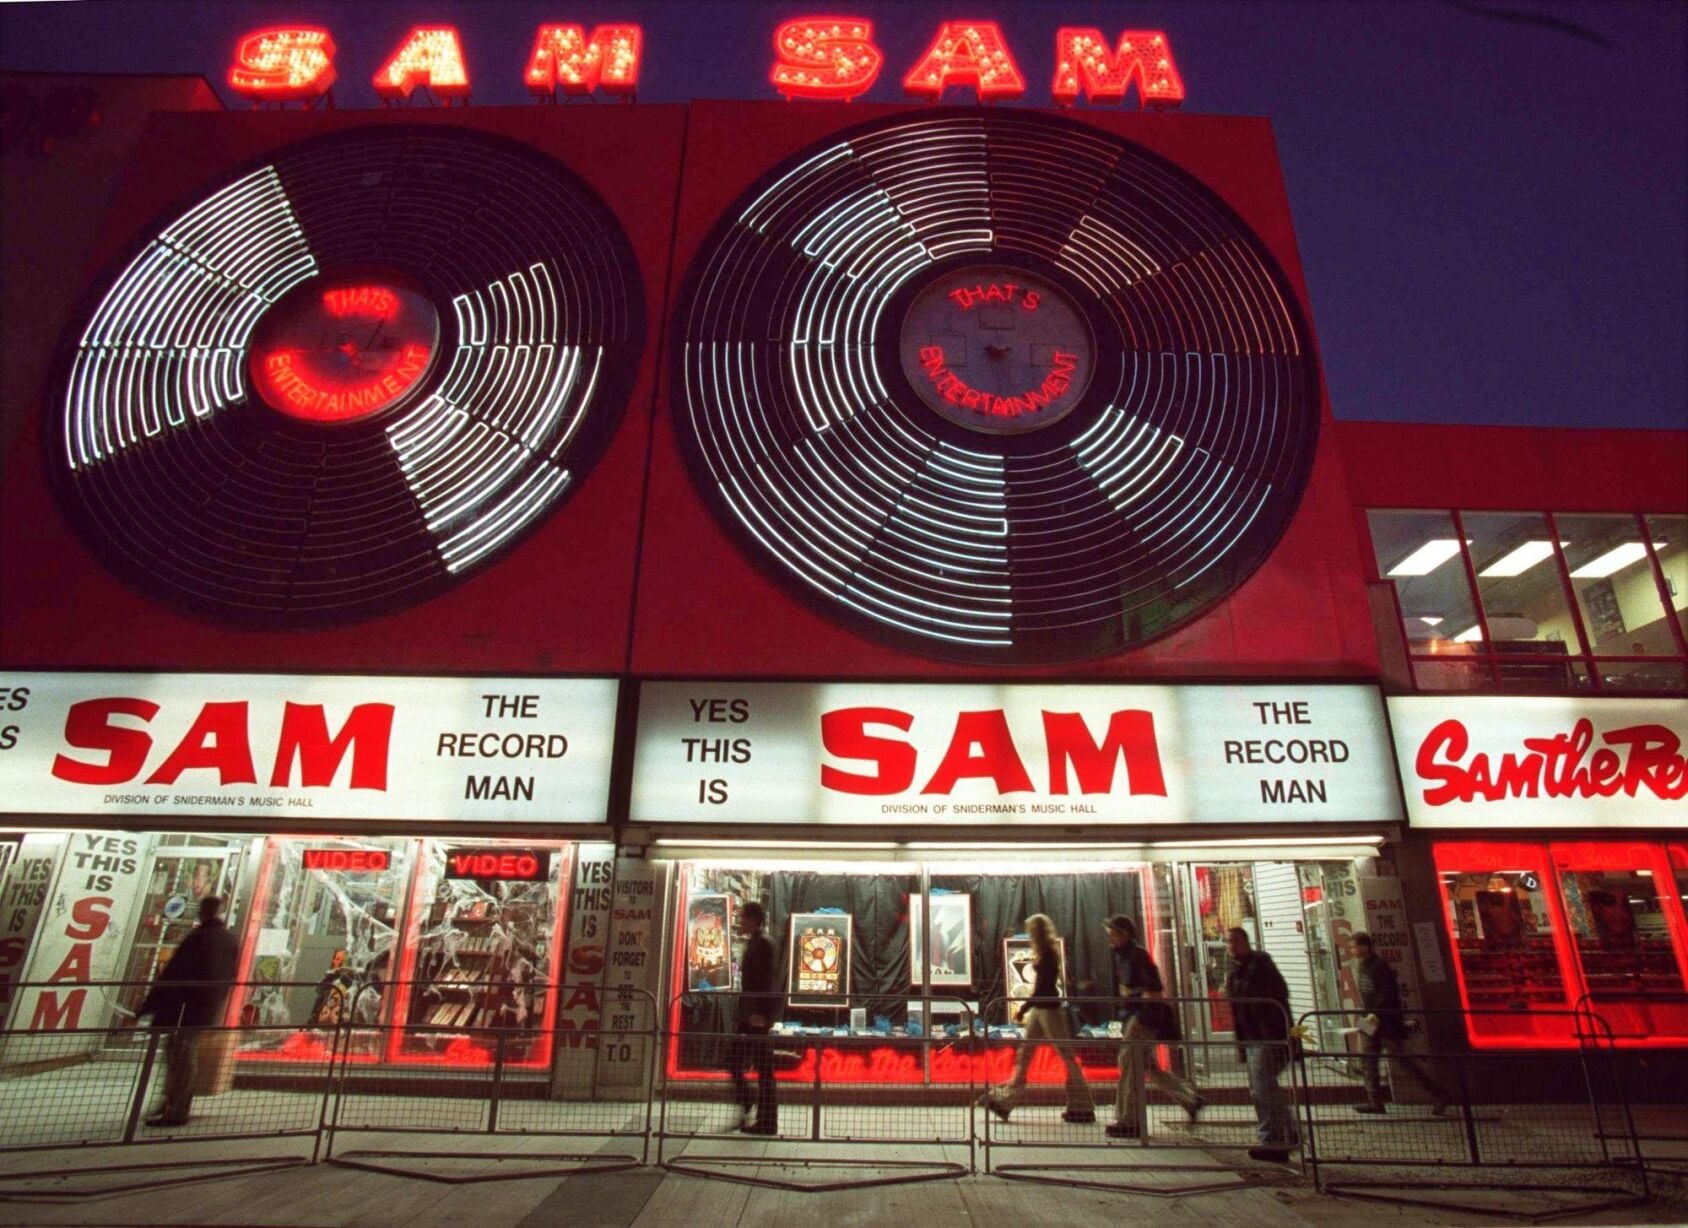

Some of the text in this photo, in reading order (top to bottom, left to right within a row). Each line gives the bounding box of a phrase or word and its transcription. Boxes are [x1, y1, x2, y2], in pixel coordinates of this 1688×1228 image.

[230, 24, 643, 97] SAM
[772, 16, 1185, 107] SAM
[265, 348, 428, 414] ENTERTAINMENT
[481, 694, 540, 719] THE
[688, 699, 749, 723] YES
[1253, 702, 1312, 725] THE
[51, 697, 396, 792] SAM
[437, 733, 569, 759] RECORD
[681, 738, 752, 764] THIS
[821, 707, 1168, 797] SAM
[1223, 740, 1350, 764] RECORD
[1602, 724, 1688, 800] Re
[464, 775, 535, 801] MAN
[698, 778, 729, 805] IS
[1259, 779, 1328, 804] MAN
[103, 794, 315, 807] DIVISION OF SNIDERMAN'S MUSIC HALL
[881, 803, 1097, 815] DIVISION OF SNIDERMAN'S MUSIC HALL
[85, 834, 138, 856] YES
[21, 858, 52, 881] YES
[74, 852, 137, 875] THIS
[305, 851, 388, 870] VIDEO
[454, 854, 539, 877] VIDEO
[84, 875, 114, 892] IS
[580, 861, 612, 885] YES
[11, 882, 47, 906] THIS
[575, 887, 612, 912] THIS
[616, 880, 654, 896] VISITORS
[613, 908, 652, 920] SAM
[1365, 899, 1402, 911] SAM
[8, 908, 27, 931] IS
[581, 914, 598, 938] IS
[1377, 914, 1395, 929] THE
[612, 951, 646, 967] FORGET
[611, 1014, 635, 1030] REST
